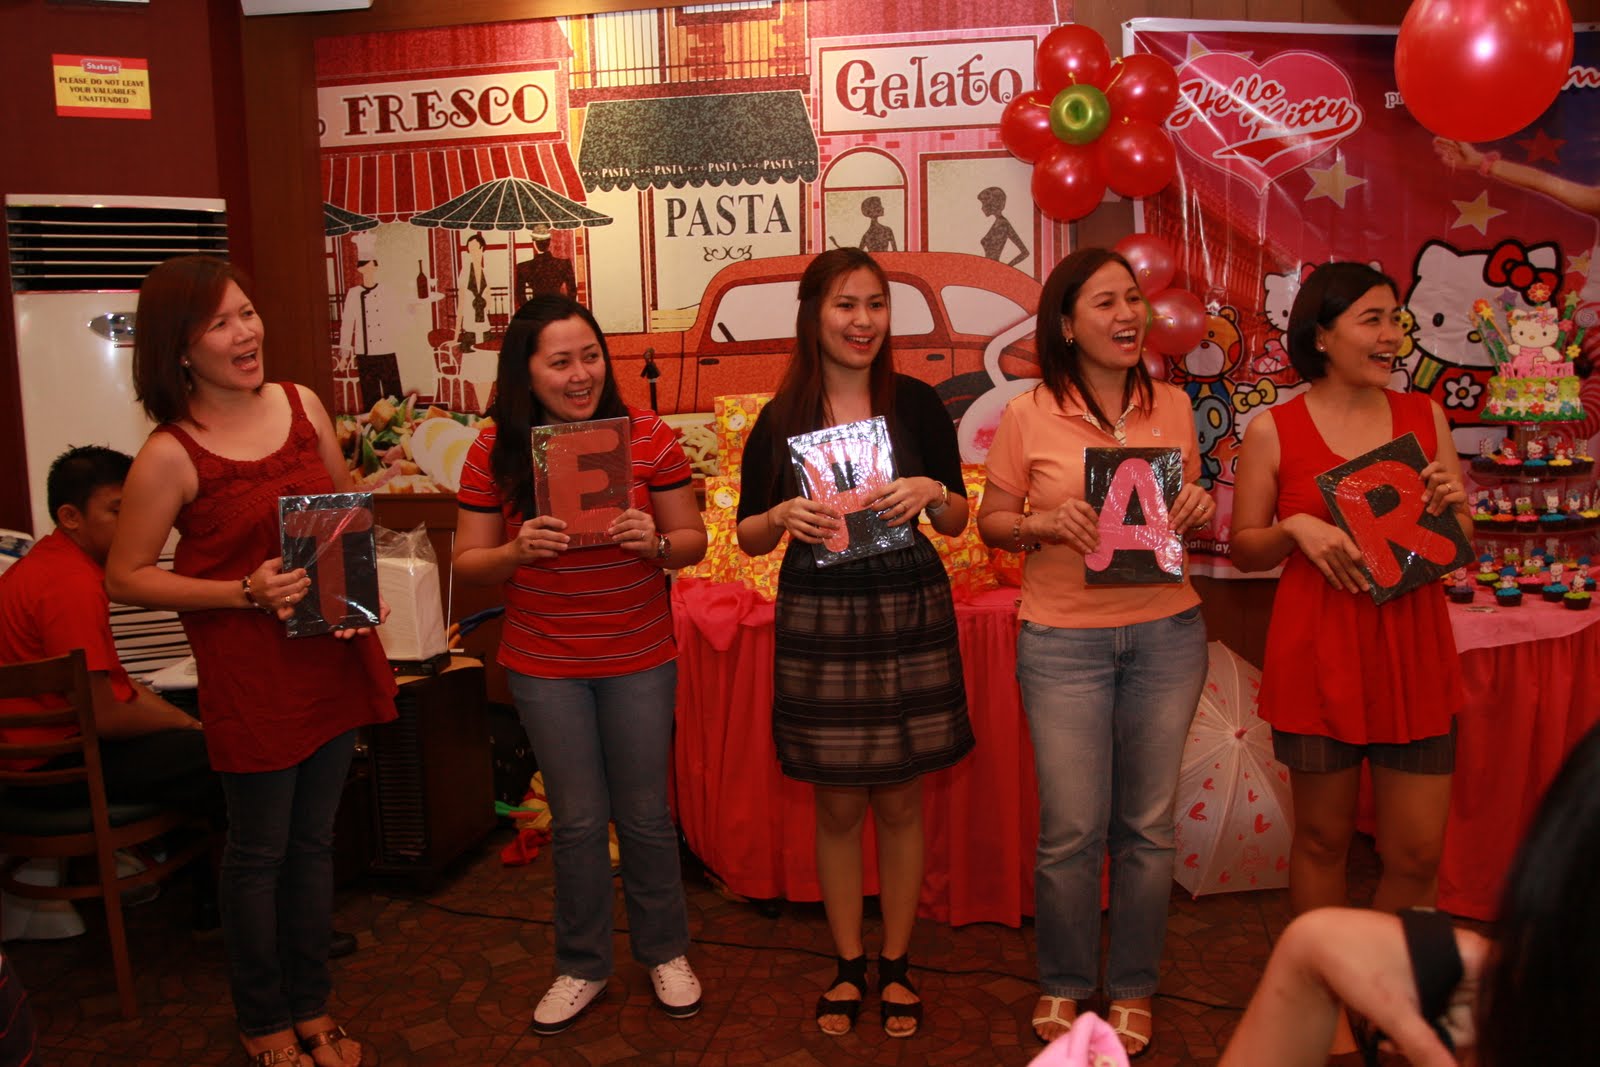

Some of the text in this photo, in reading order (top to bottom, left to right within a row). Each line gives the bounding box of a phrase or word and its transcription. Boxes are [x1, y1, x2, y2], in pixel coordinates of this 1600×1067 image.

[78, 95, 129, 104] UNATTENDED
[93, 86, 137, 95] VALUABLES
[343, 83, 549, 137] FRESCO
[835, 53, 1023, 118] Gelato
[1167, 75, 1286, 130] Hello
[1241, 97, 1358, 139] Kitty
[602, 159, 794, 178] PASTA PASTA PASTA PASTA
[665, 193, 792, 238] PASTA
[546, 428, 626, 537] E
[1085, 457, 1182, 574] A
[1335, 460, 1457, 588] R
[284, 506, 373, 625] T
